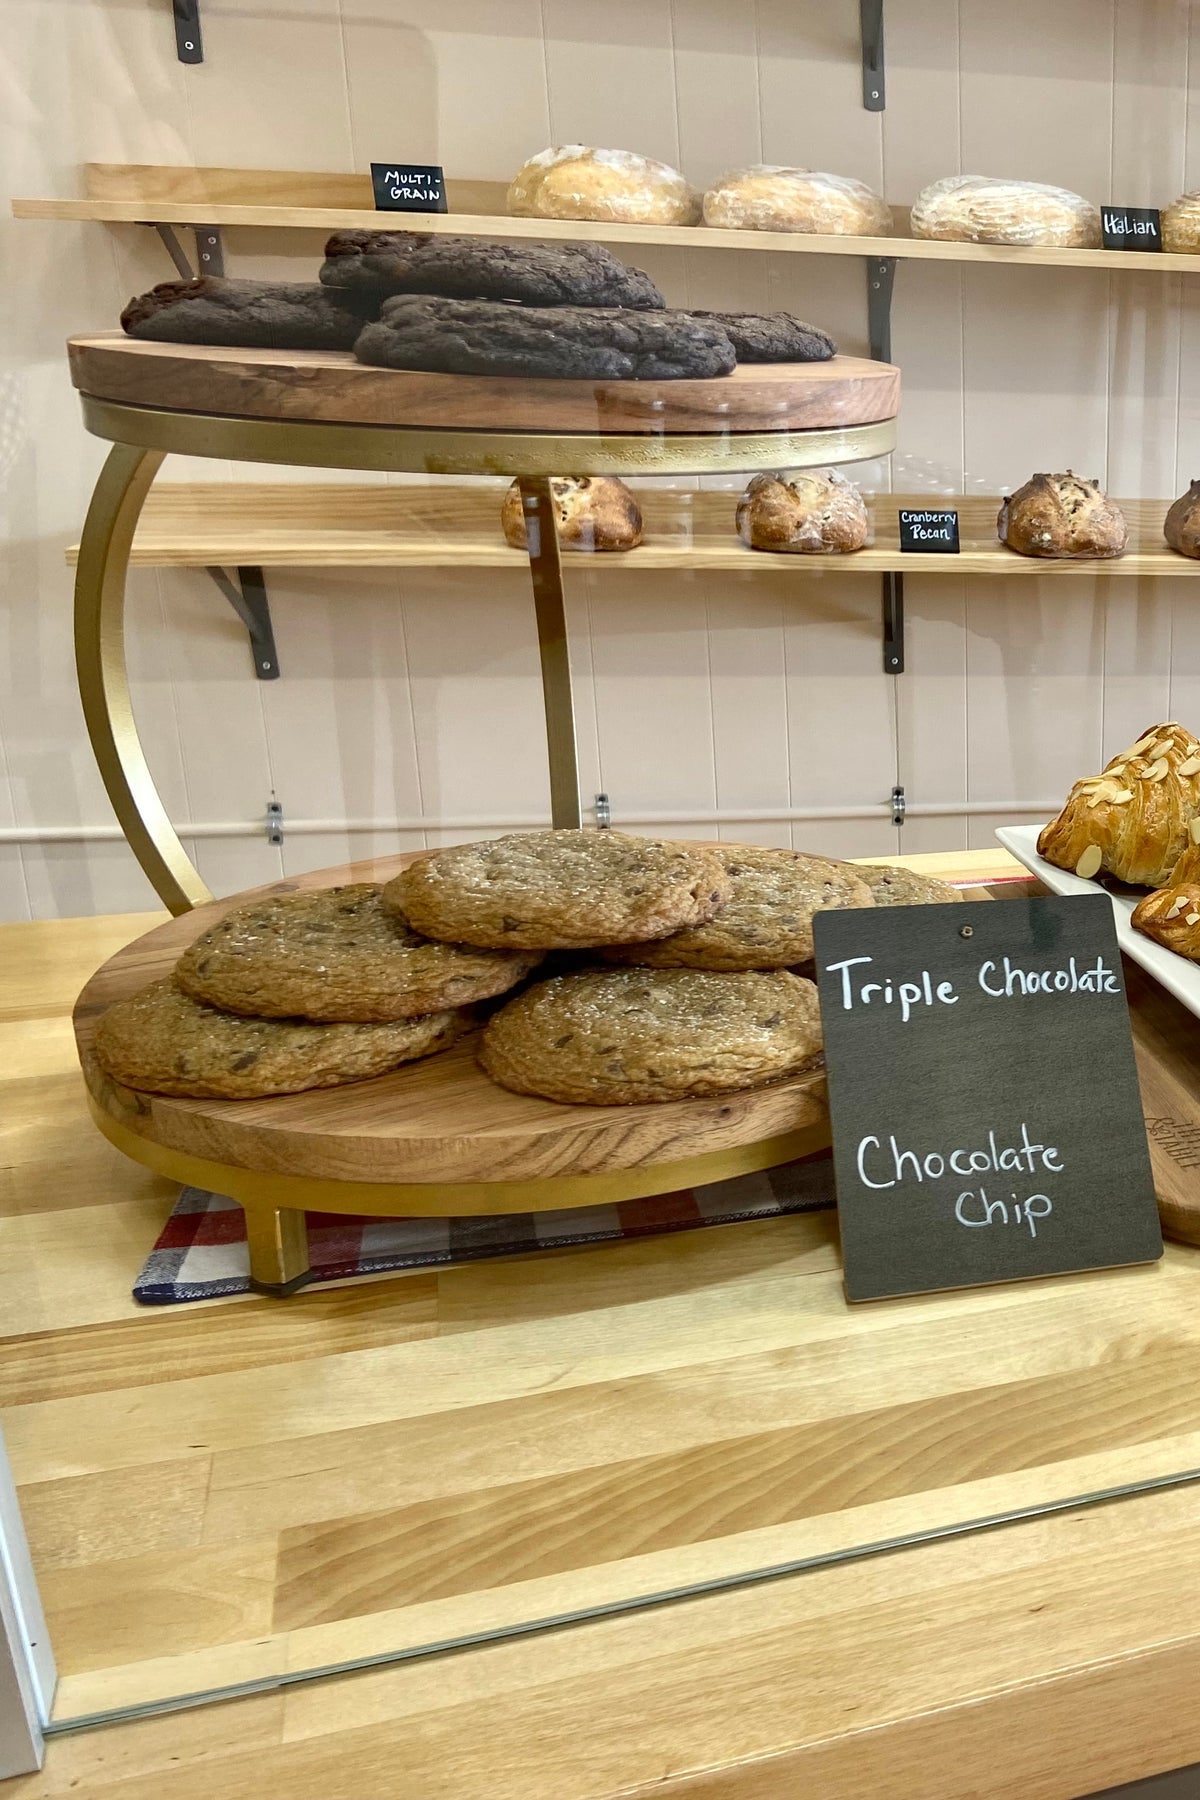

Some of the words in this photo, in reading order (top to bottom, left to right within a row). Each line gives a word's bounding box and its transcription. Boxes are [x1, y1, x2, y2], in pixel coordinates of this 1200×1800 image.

[384, 170, 441, 185] MULTI-
[390, 186, 440, 200] GRAIN
[901, 511, 957, 525] Cranberry
[909, 523, 951, 540] Pecan
[825, 956, 959, 1022] Triple
[978, 956, 1121, 997] Chocolate
[857, 1123, 1065, 1189] Chocolate
[955, 1187, 1053, 1238] Chip
